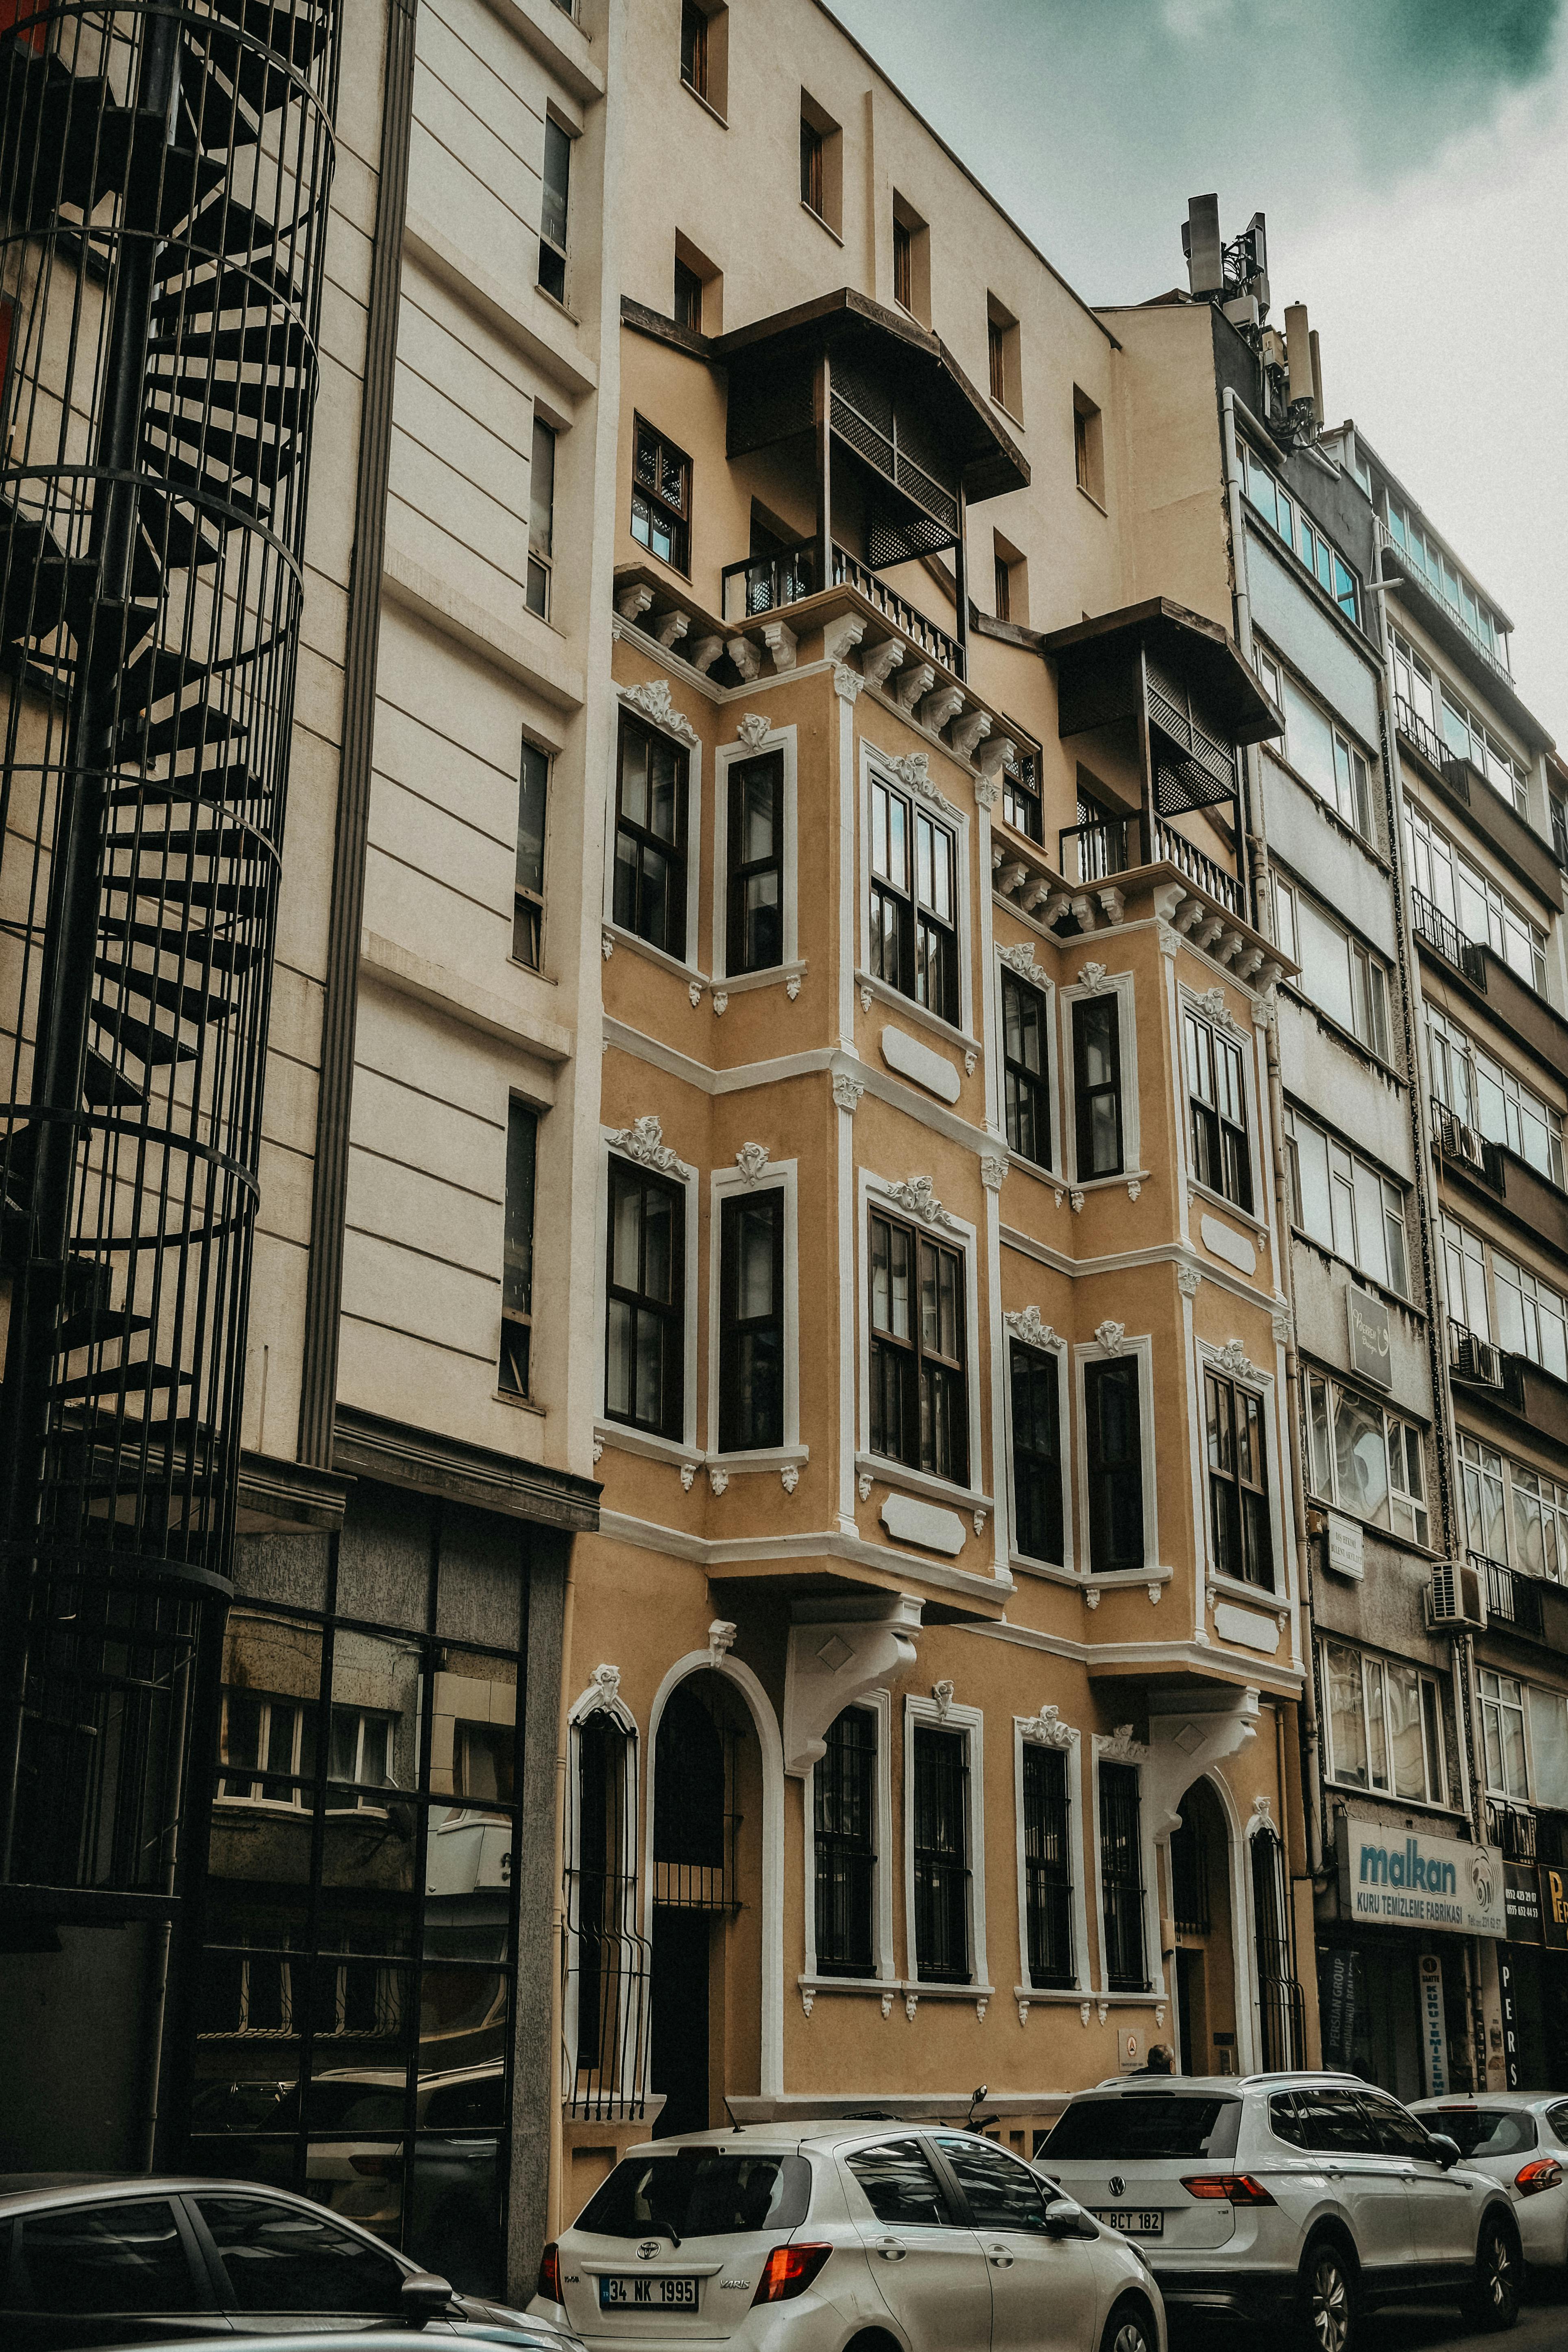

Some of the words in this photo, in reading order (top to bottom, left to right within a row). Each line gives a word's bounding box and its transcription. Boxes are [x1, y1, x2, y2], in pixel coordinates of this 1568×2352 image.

[1360, 1836, 1456, 1896] malkan
[1357, 1892, 1380, 1912] KURU
[1382, 1893, 1424, 1919] TEMİZLEME
[1426, 1899, 1462, 1924] FABRİKASI
[1333, 1958, 1344, 1997] GROUP
[1330, 1999, 1341, 2047] PERSIAN
[1111, 2213, 1132, 2229] BCT
[1138, 2213, 1159, 2229] 182
[610, 2280, 627, 2301] 34
[635, 2280, 652, 2302] NK
[660, 2281, 693, 2302] 1995
[720, 2280, 750, 2290] YARIS
